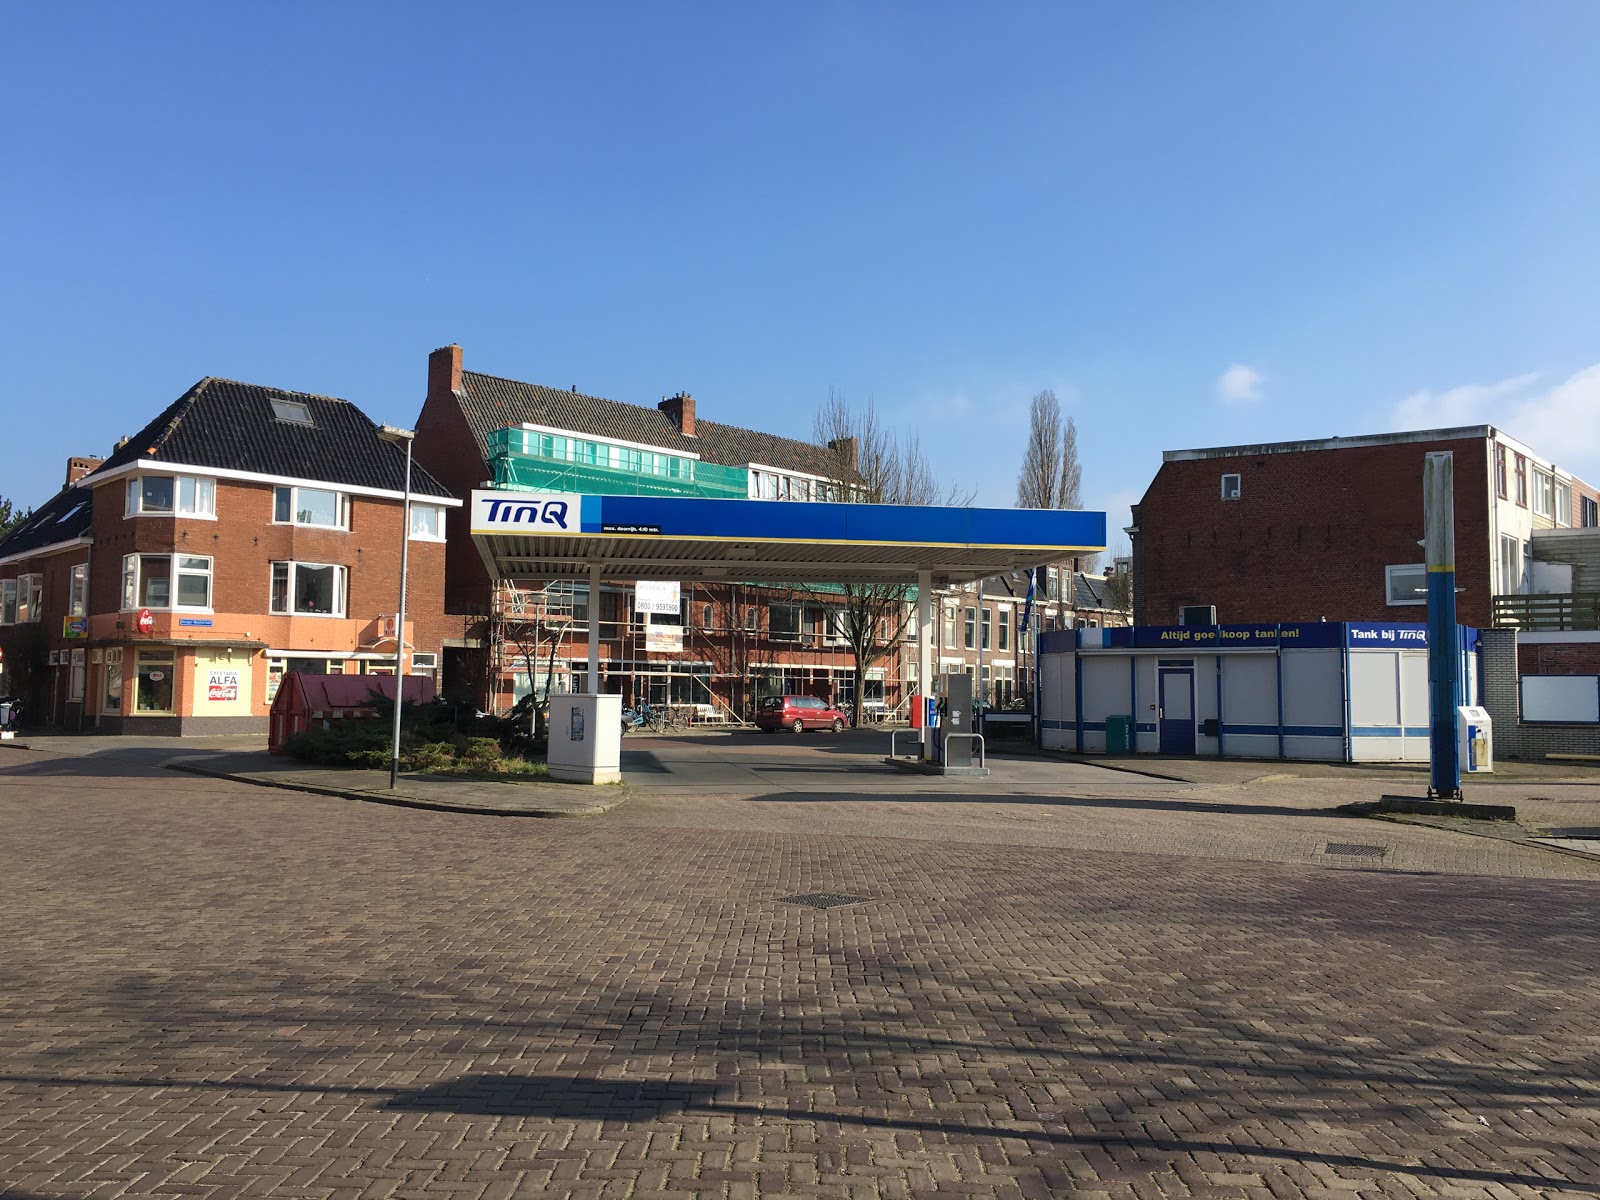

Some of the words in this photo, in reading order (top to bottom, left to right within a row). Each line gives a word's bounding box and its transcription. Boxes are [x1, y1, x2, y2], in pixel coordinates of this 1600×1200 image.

[1161, 631, 1190, 641] Altijd
[1351, 629, 1378, 639] Tank
[1381, 630, 1395, 641] bij
[210, 676, 237, 684] ALFA
